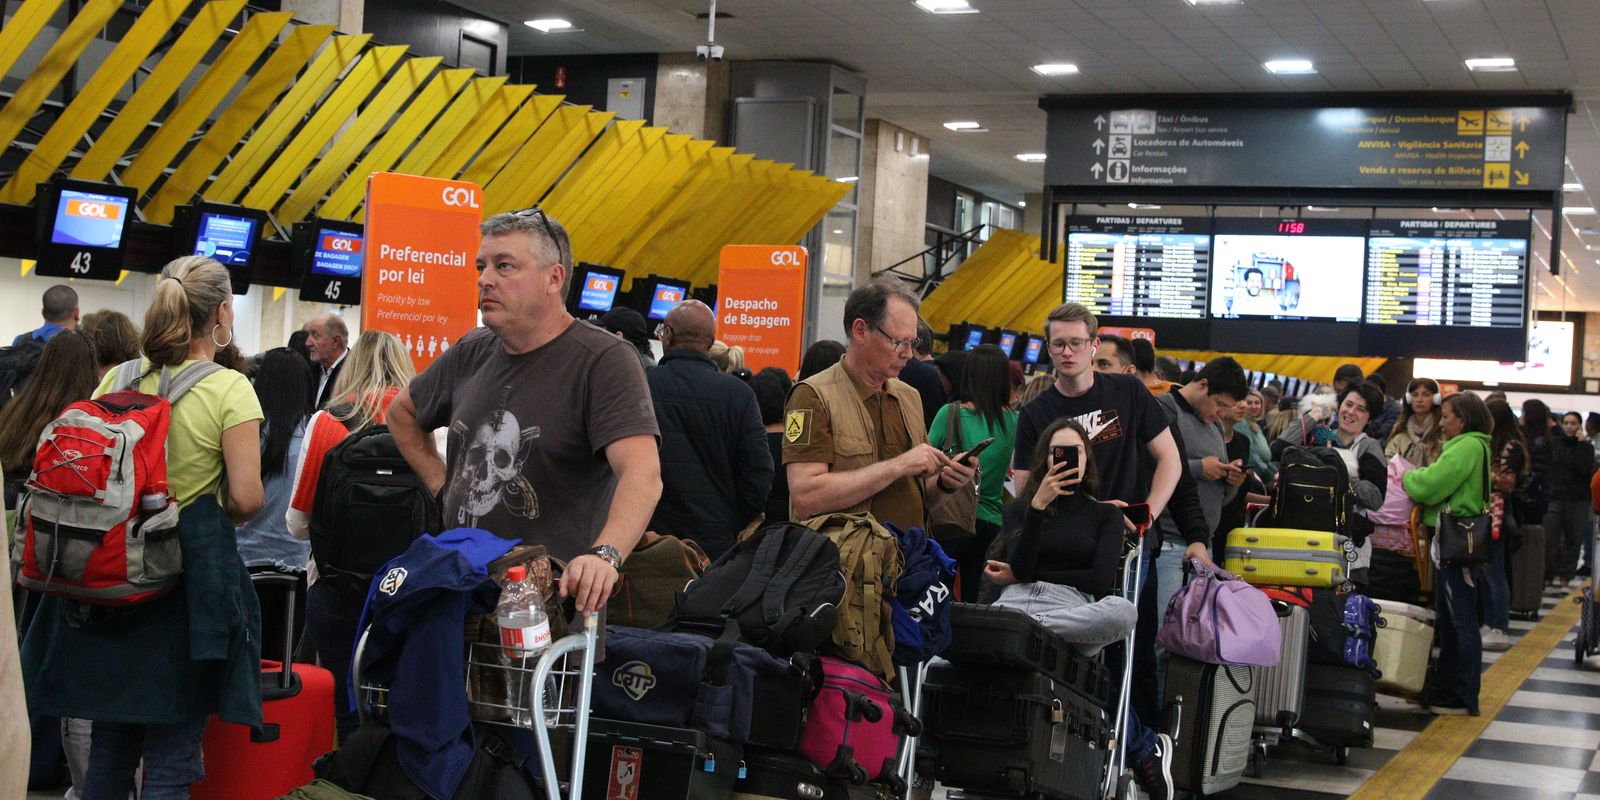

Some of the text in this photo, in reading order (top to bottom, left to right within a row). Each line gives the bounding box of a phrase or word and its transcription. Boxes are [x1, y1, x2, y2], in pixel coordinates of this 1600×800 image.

[1180, 114, 1208, 123] Ônibus
[1395, 115, 1456, 125] Desembarque
[1134, 138, 1244, 147] Locadoras de Automóveis
[1398, 140, 1440, 150] Vigilância
[1132, 166, 1187, 174] Informações
[1360, 166, 1388, 174] Venda
[1434, 166, 1446, 174] de
[442, 186, 479, 208] GOL
[78, 202, 107, 218] GOL
[1400, 220, 1438, 228] PARTIDAS
[1444, 221, 1496, 229] DEPARTURES
[332, 238, 352, 252] GOL
[380, 244, 466, 266] Preferencial
[770, 250, 800, 266] GOL
[70, 252, 92, 274] 43
[379, 268, 424, 284] por lei
[325, 280, 342, 300] 45
[594, 280, 608, 291] GOL
[378, 293, 430, 306] Priority by law
[662, 291, 675, 301] GOL
[726, 297, 778, 312] Despacho
[377, 310, 448, 325] Preferencial por ley
[724, 312, 790, 328] de Bagagem
[748, 334, 762, 342] drop
[1131, 331, 1152, 340] GOL
